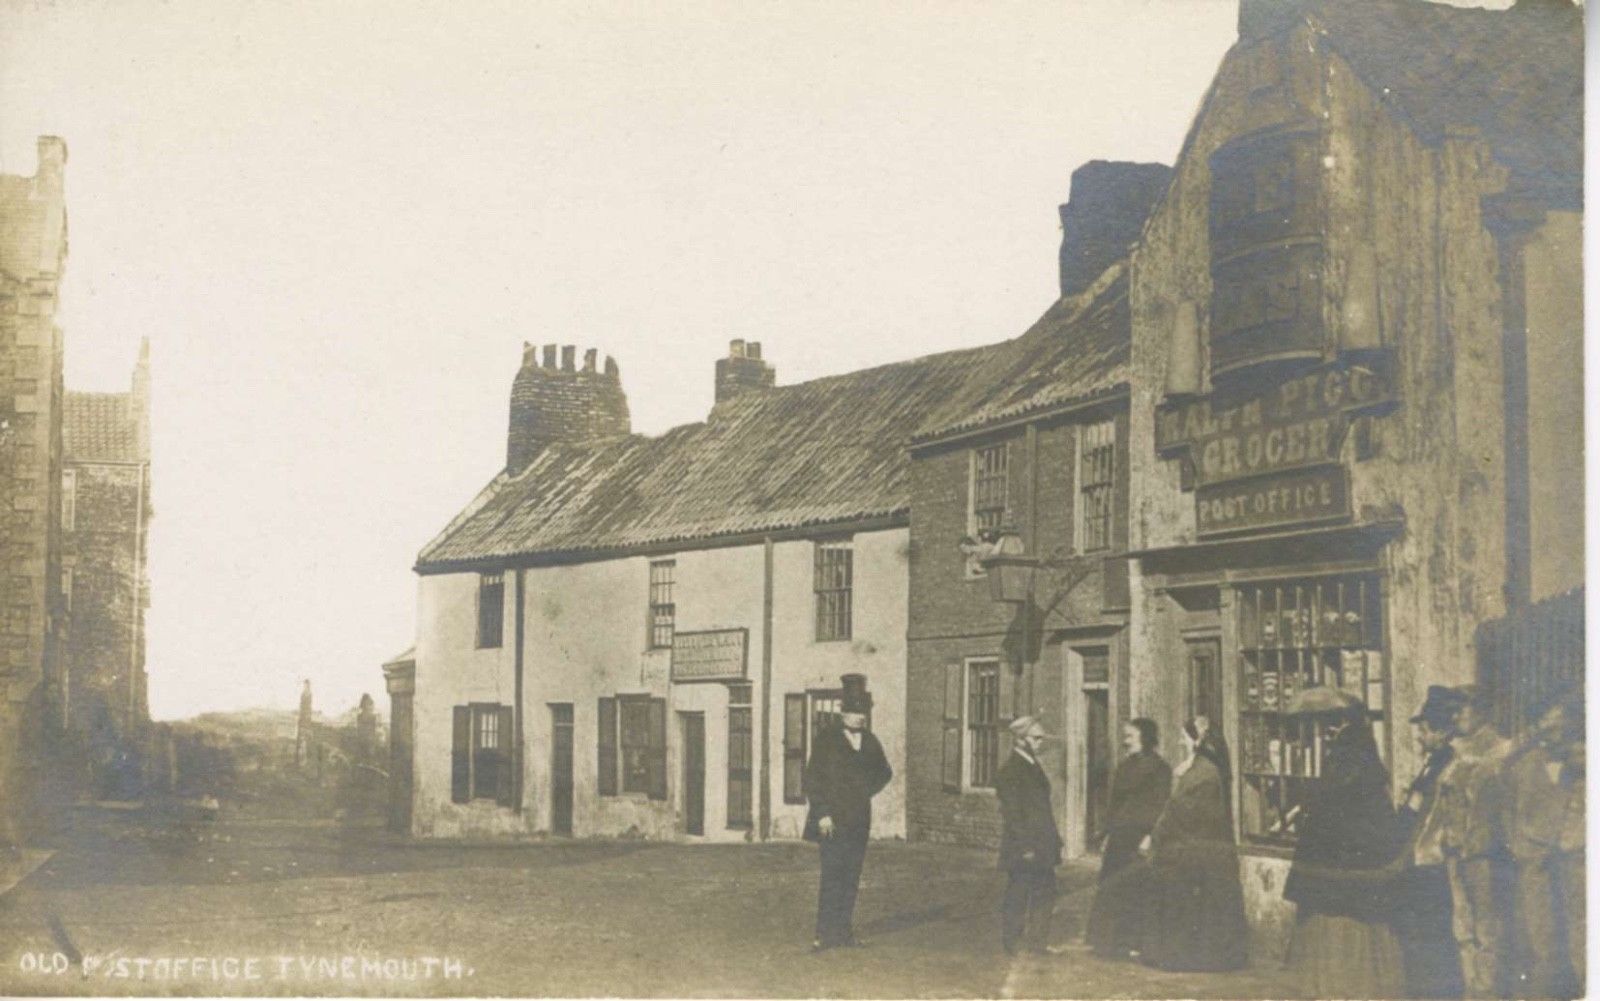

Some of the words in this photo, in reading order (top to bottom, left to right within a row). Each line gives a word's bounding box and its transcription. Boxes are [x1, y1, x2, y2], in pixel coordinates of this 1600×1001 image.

[1203, 418, 1330, 474] GROCER
[1199, 494, 1250, 522] POST
[1254, 482, 1332, 513] OFFICE
